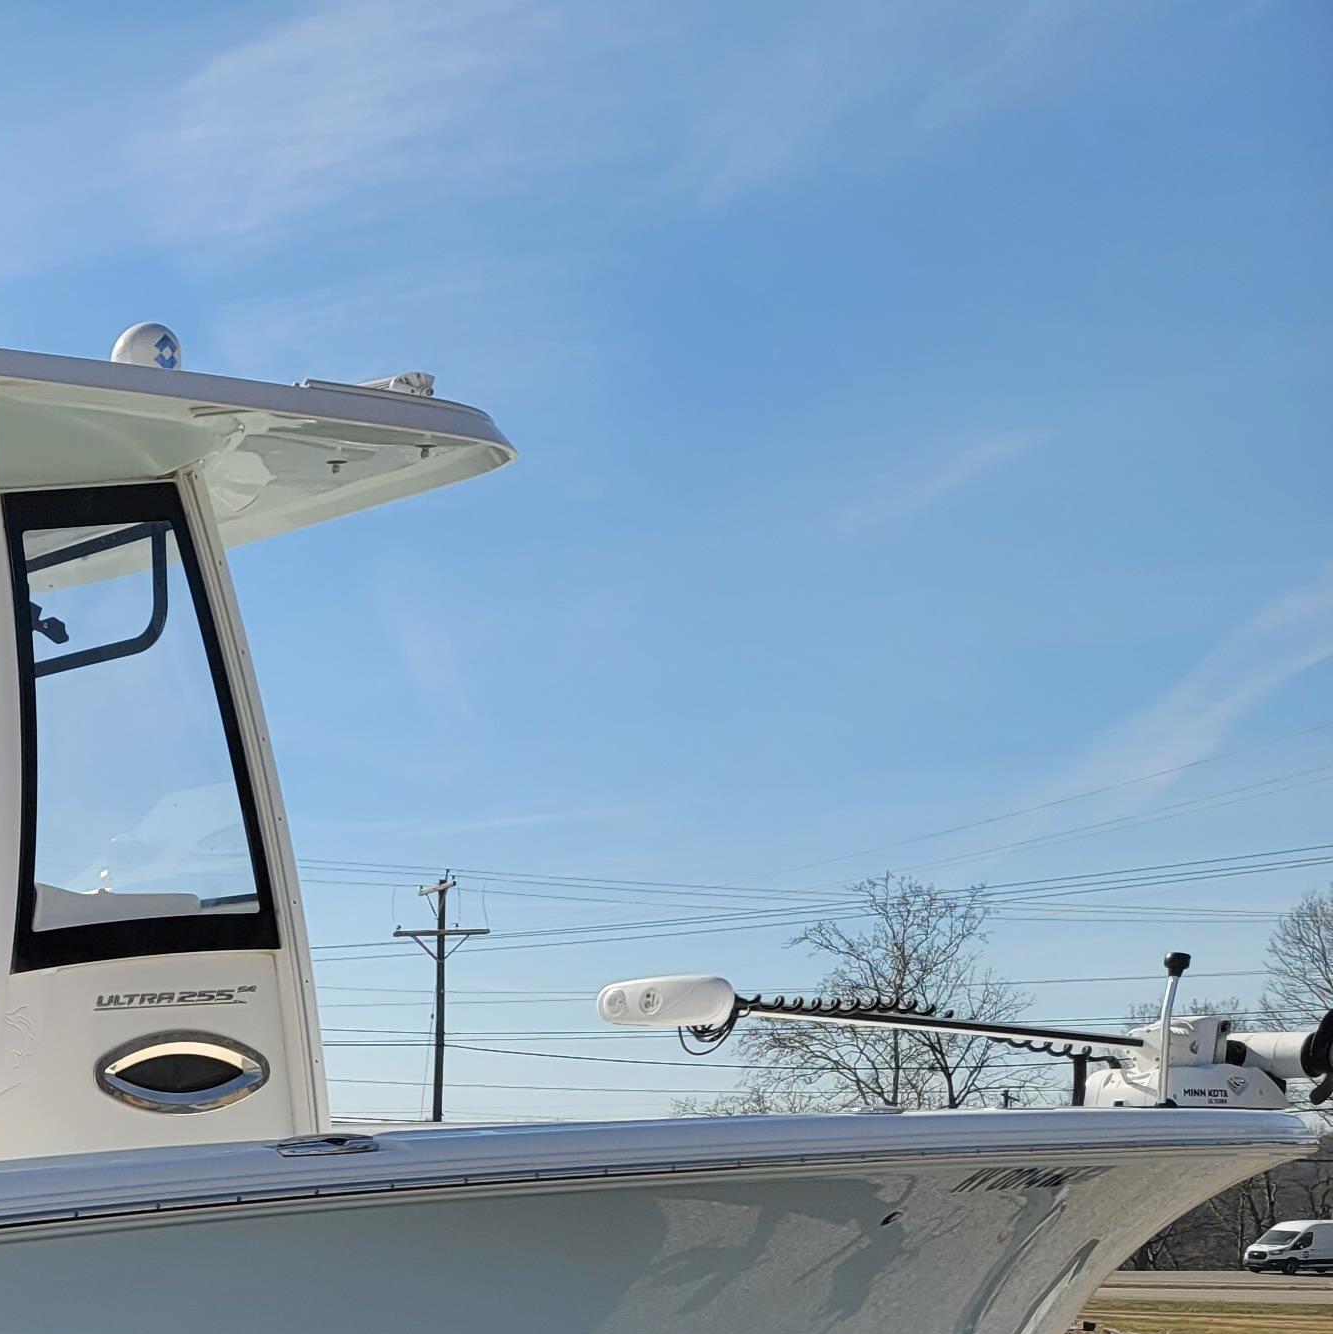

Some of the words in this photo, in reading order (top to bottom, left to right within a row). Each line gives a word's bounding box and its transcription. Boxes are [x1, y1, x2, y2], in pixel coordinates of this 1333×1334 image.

[96, 992, 175, 1007] ULTRA
[176, 989, 235, 1003] 255
[1183, 1088, 1206, 1098] MINN
[1207, 1089, 1228, 1098] KOTA
